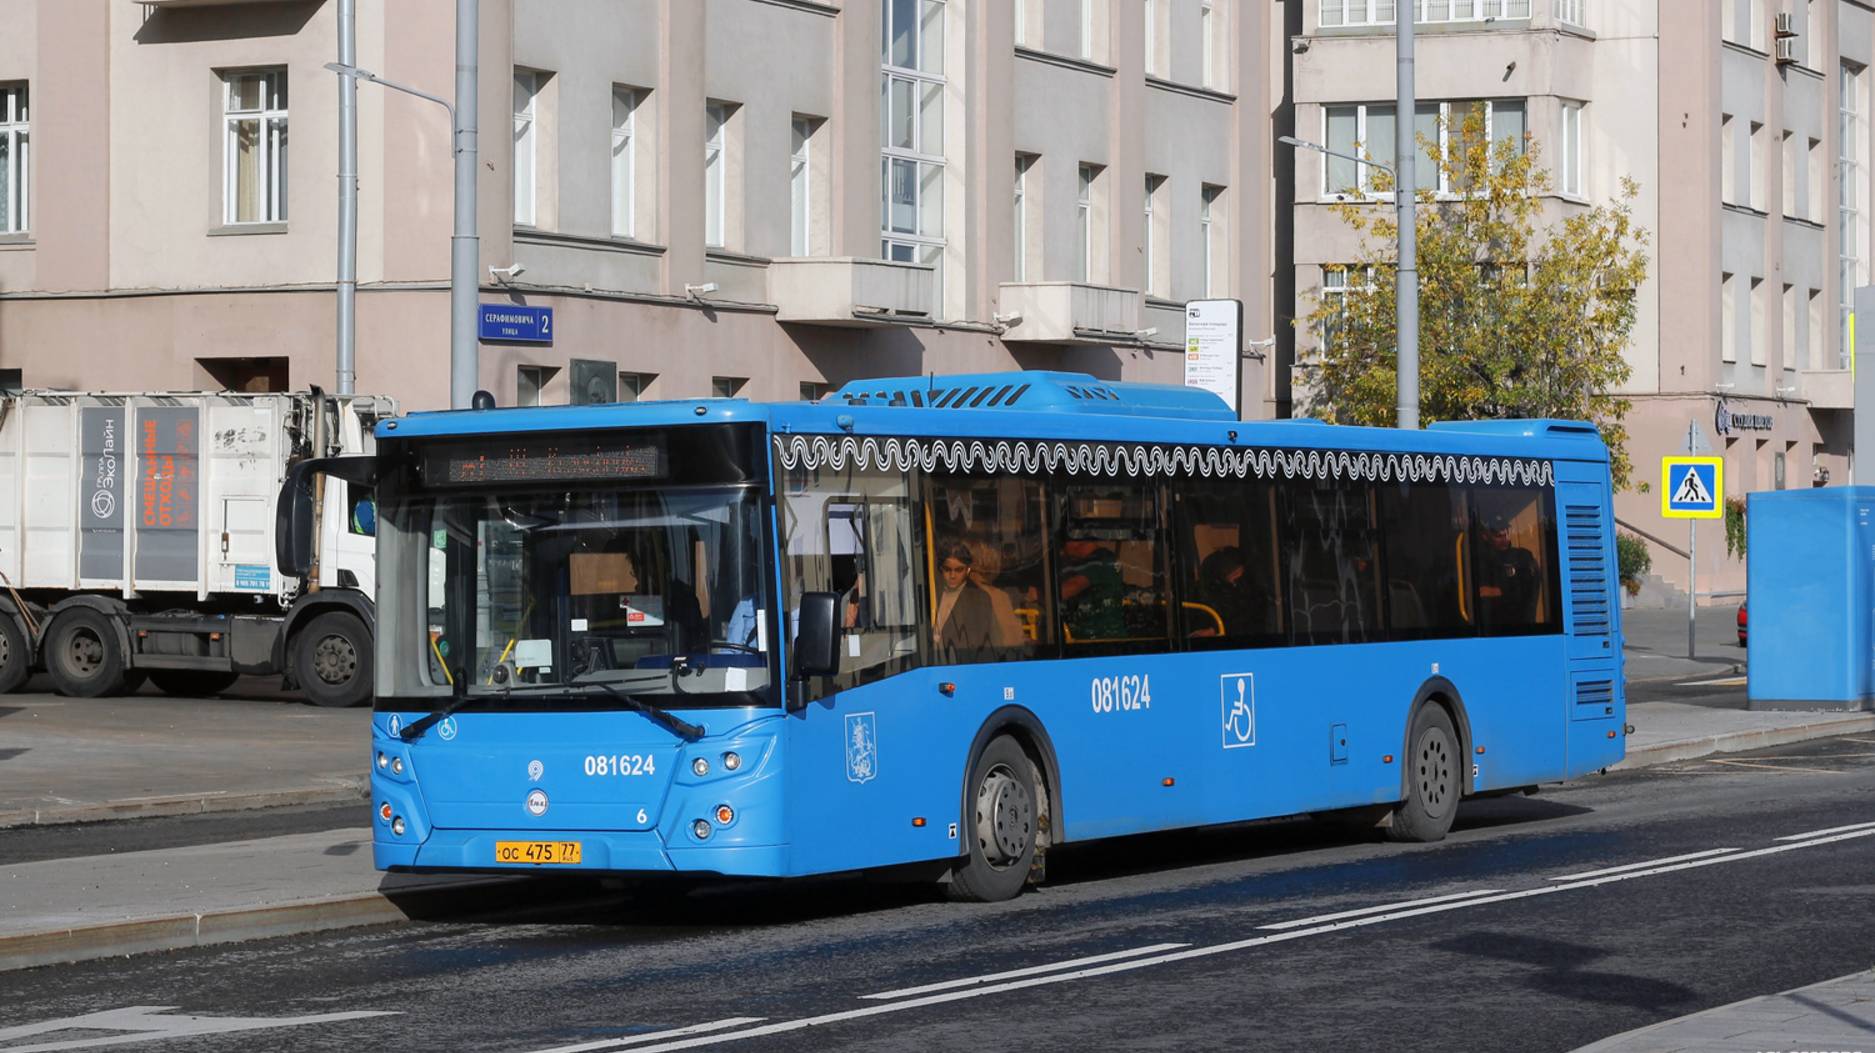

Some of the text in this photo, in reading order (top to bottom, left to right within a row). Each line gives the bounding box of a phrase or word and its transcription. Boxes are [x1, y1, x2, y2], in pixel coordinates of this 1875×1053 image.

[485, 313, 549, 333] СЕРАФИМОВИЧА 2
[502, 327, 518, 335] УЛИЦА
[103, 419, 116, 489] ЭкоЛайн
[144, 420, 157, 526] СМЕШАННЫЕ
[159, 455, 175, 526] ОТХОДЫ
[1091, 674, 1151, 713] 081624
[584, 755, 655, 776] 081624
[636, 809, 648, 824] 6
[526, 844, 552, 860] 475
[561, 843, 575, 856] 77
